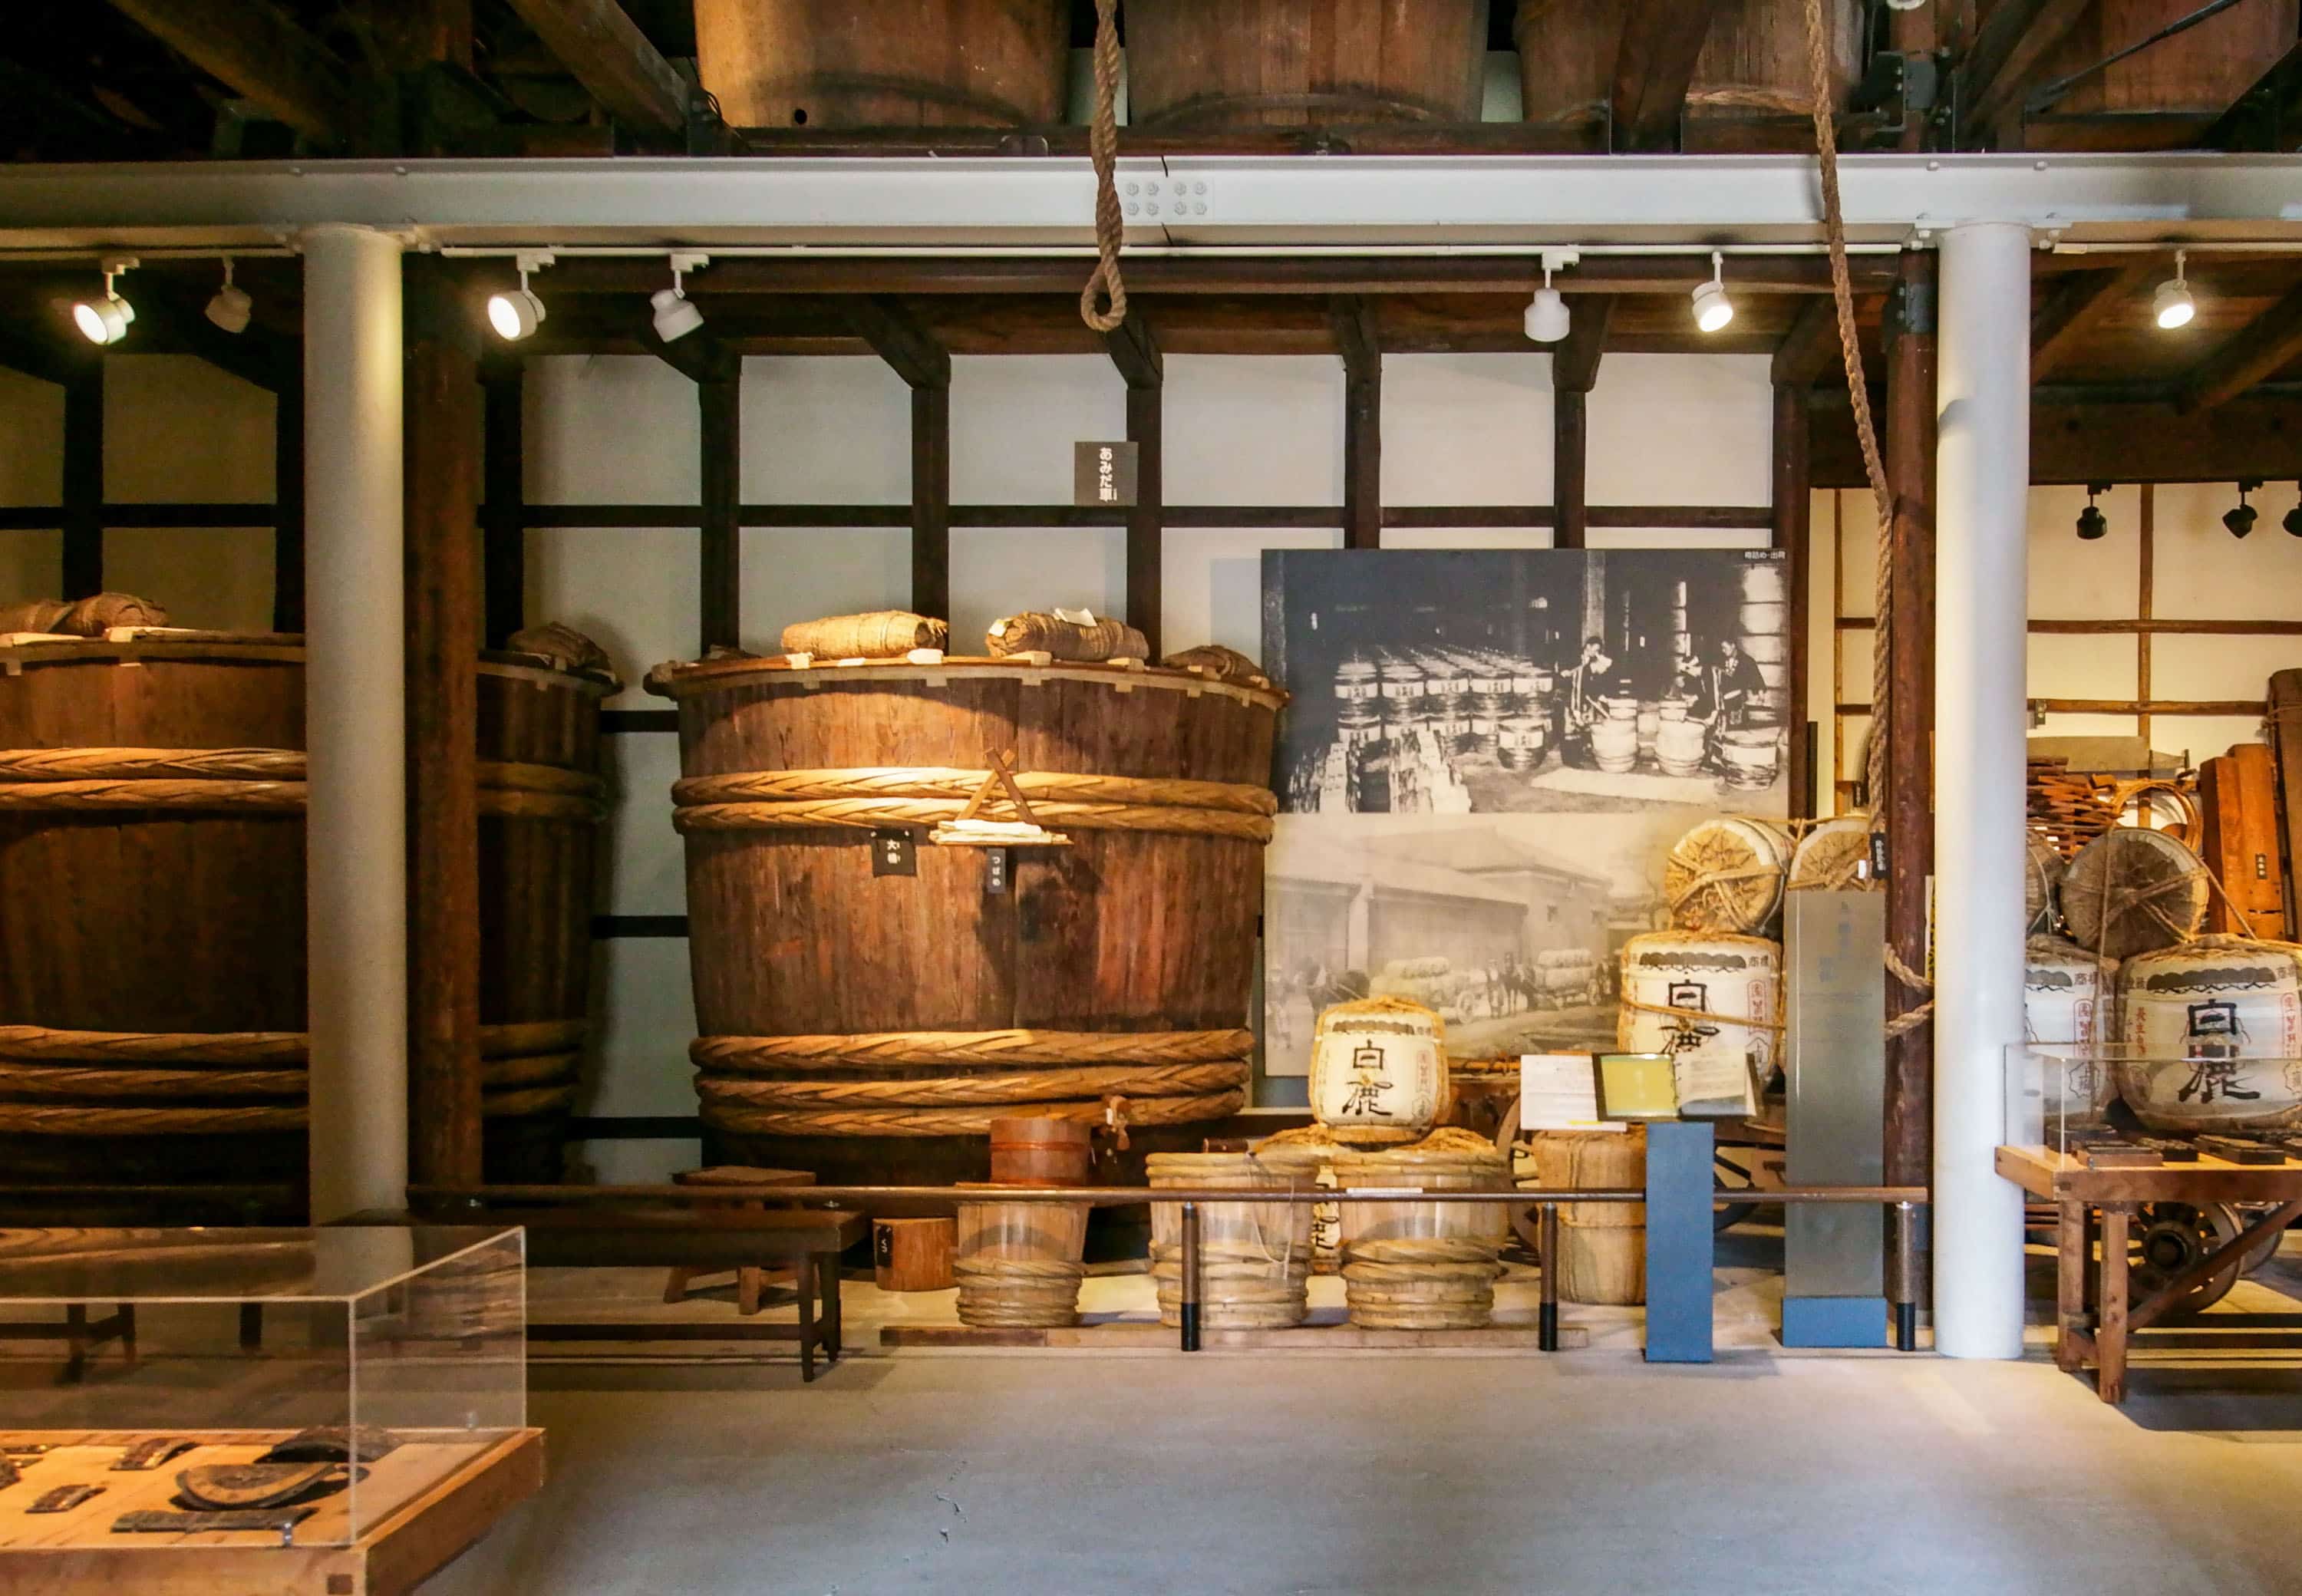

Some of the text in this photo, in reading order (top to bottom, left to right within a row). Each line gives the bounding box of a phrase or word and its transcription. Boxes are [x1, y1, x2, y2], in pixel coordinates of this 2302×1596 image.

[1099, 447, 1113, 502] あみだ車
[1341, 1038, 1394, 1116] 白鹿
